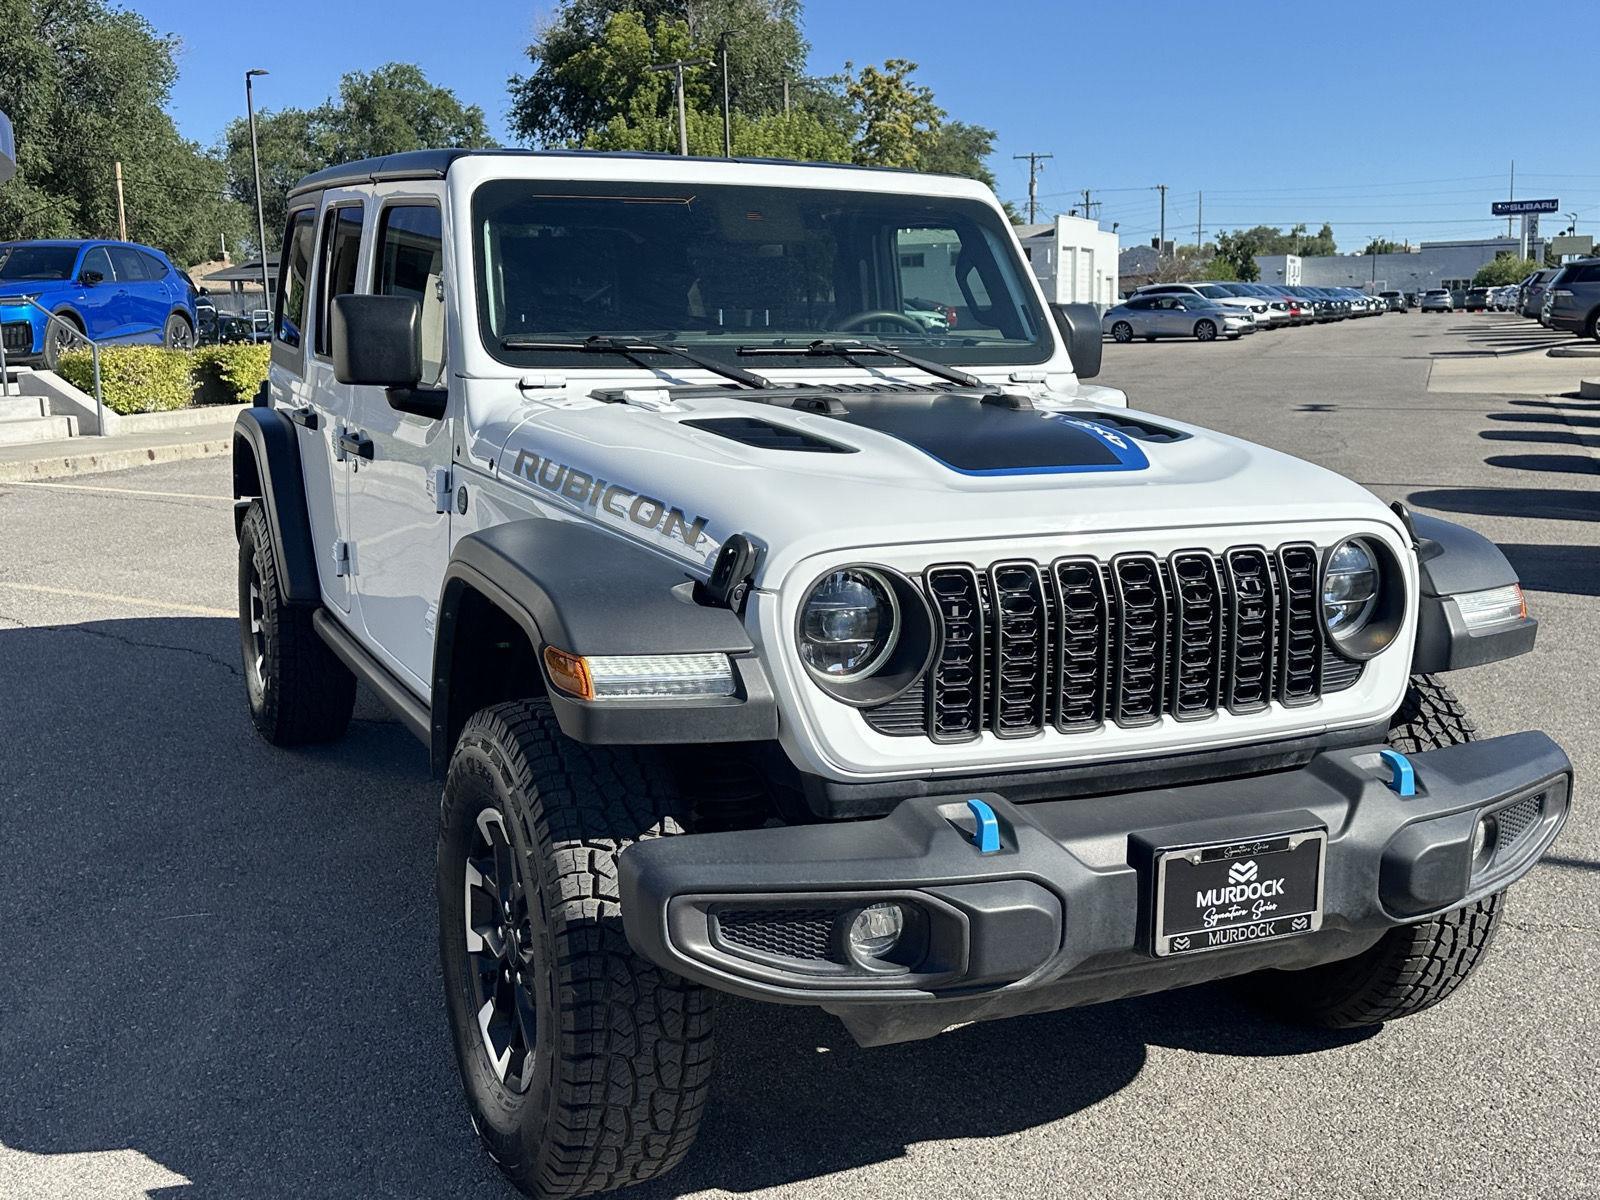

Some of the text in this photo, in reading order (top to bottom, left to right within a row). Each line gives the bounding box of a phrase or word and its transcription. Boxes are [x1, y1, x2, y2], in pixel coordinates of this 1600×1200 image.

[1510, 201, 1557, 211] SUBARU
[512, 447, 710, 547] RUBICON
[1196, 877, 1285, 908] MURDOCK
[1203, 899, 1278, 928] Signature Series
[1208, 922, 1276, 946] MURDOCK
